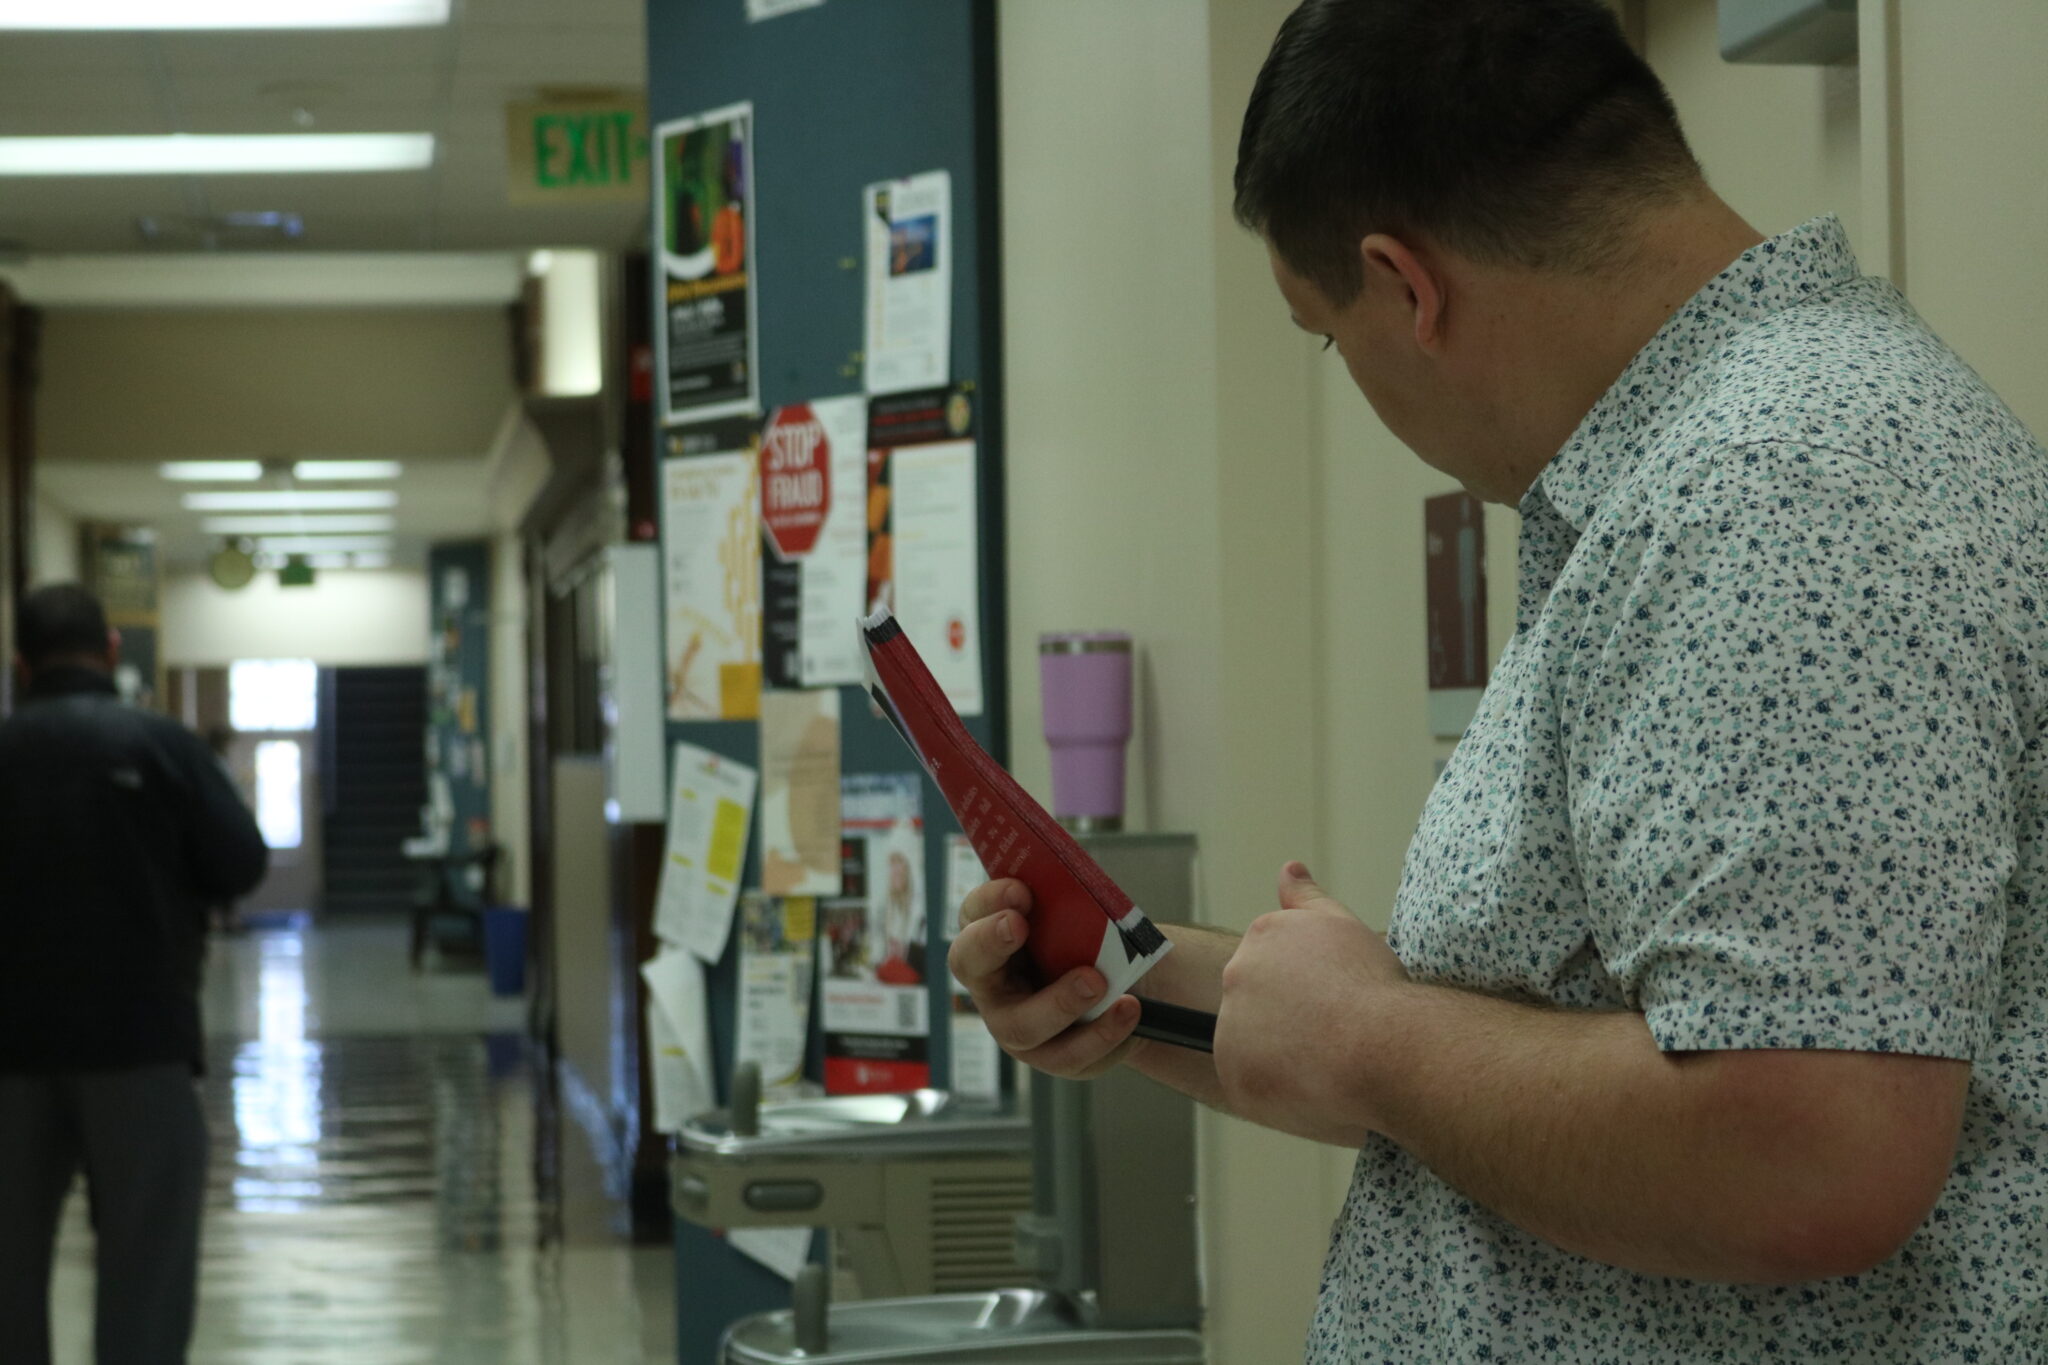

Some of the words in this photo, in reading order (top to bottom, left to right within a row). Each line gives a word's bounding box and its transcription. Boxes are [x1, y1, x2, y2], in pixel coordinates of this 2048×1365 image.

[538, 113, 631, 186] EXIT
[769, 420, 821, 471] STOP
[768, 470, 823, 511] FRAUD
